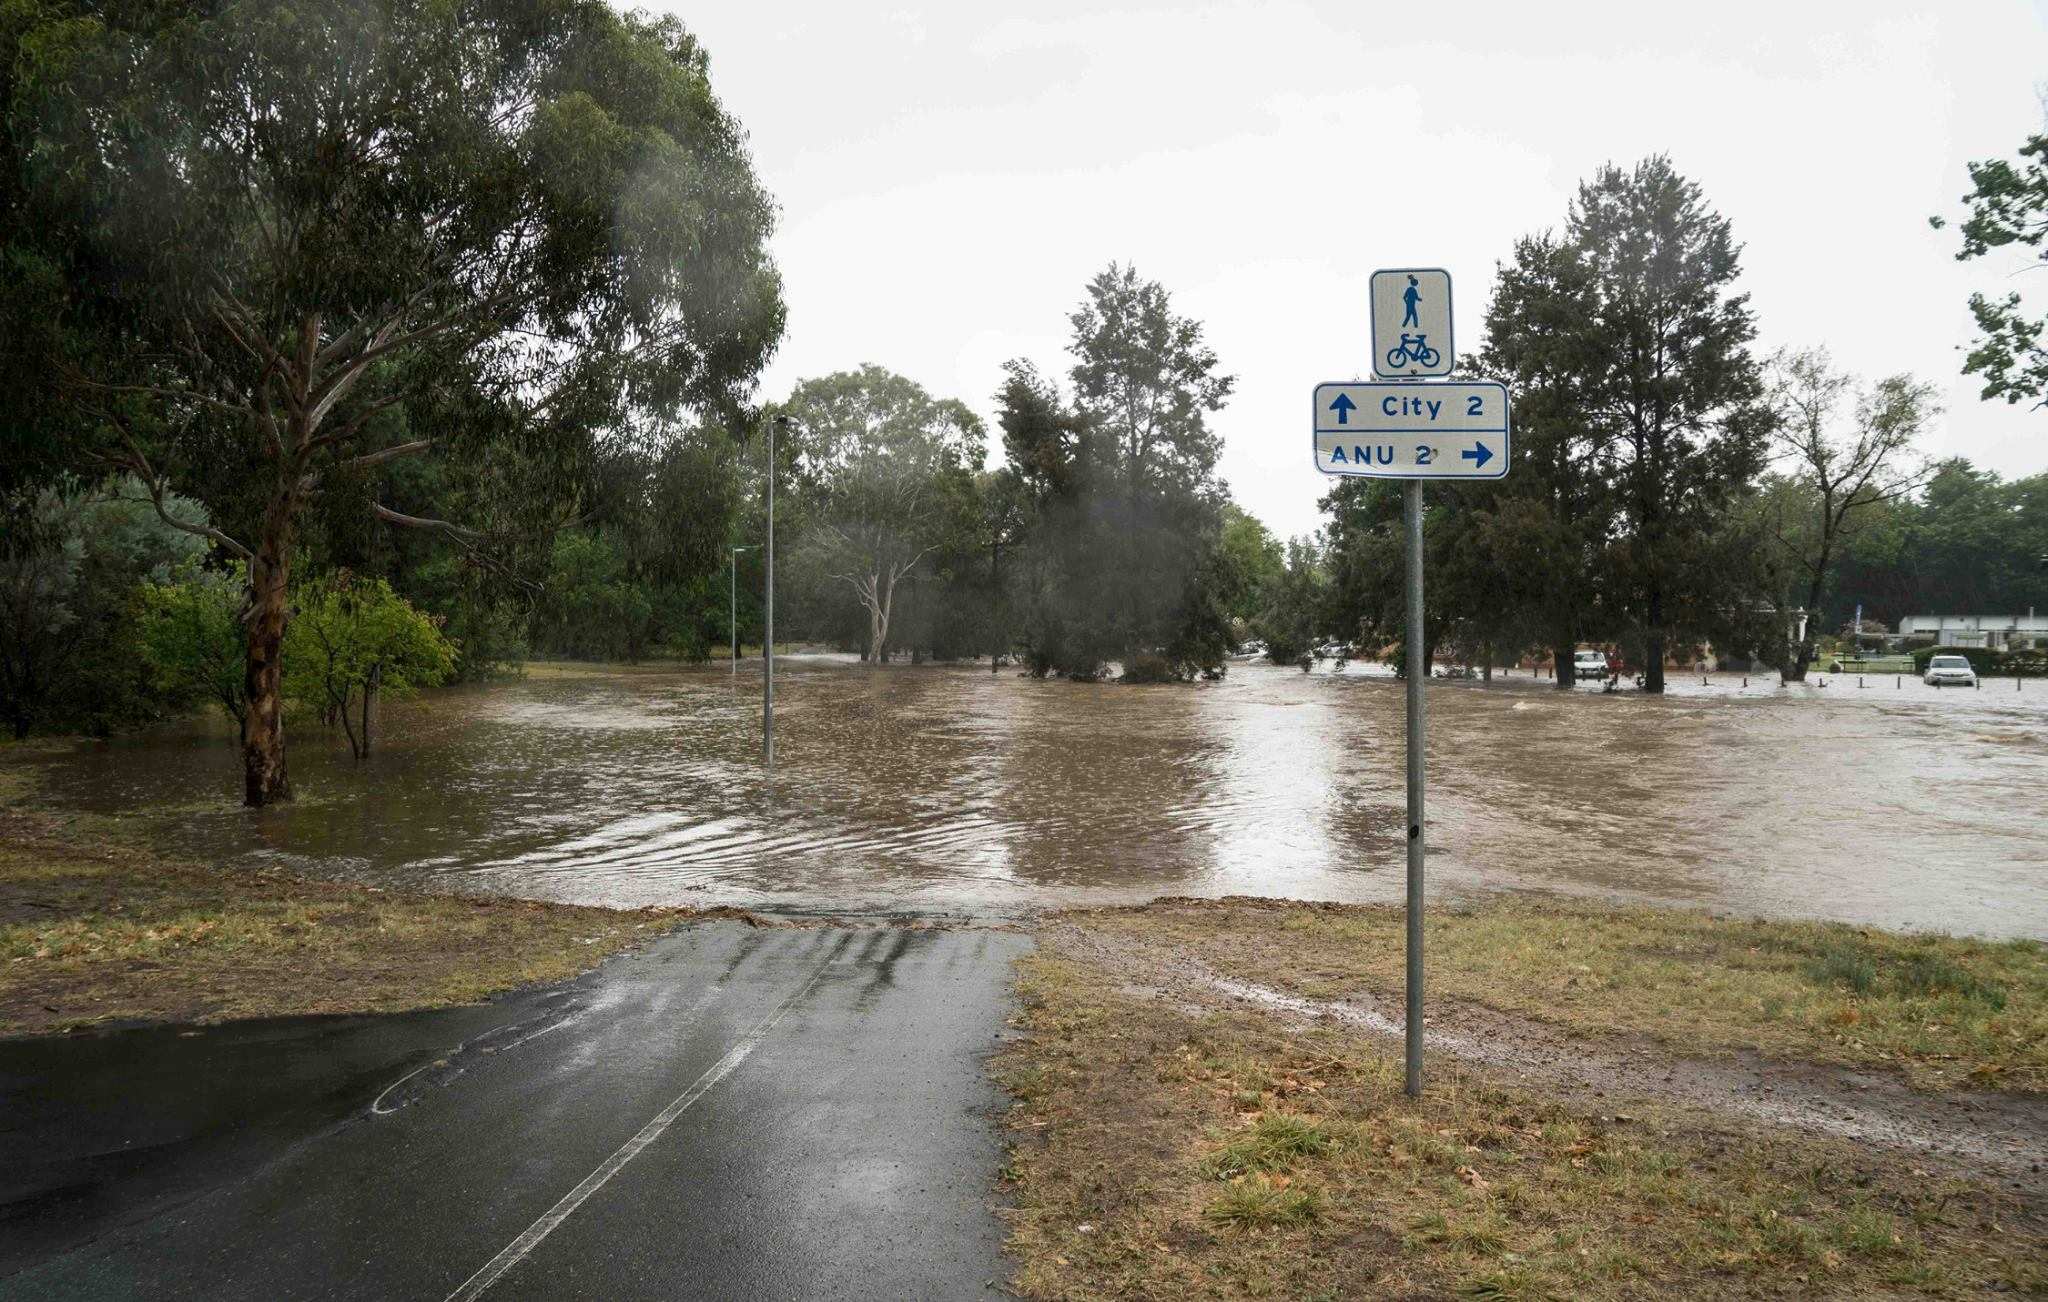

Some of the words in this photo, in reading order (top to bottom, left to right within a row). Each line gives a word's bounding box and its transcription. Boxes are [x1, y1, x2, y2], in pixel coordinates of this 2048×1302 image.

[1382, 396, 1441, 420] City
[1467, 396, 1483, 416] 2
[1331, 446, 1394, 465] ANU
[1415, 446, 1431, 464] 2
